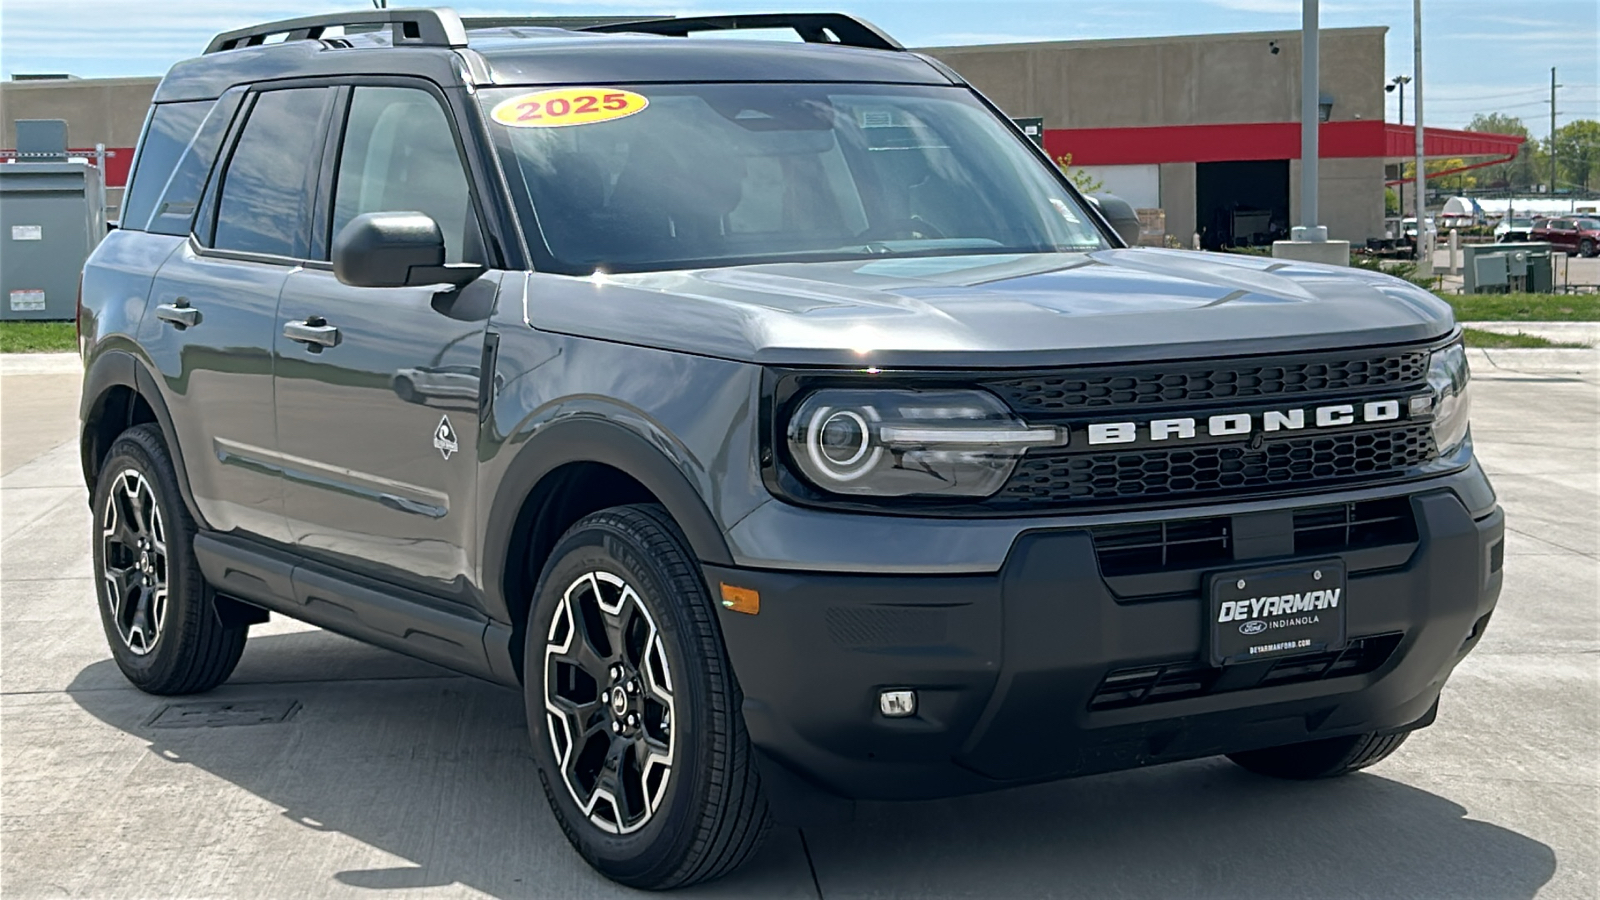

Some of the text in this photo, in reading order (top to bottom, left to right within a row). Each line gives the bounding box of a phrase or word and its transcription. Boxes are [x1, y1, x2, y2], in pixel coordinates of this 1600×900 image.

[516, 93, 628, 121] 2025
[1088, 400, 1399, 445] BRONCO
[1218, 588, 1340, 622] DEYARMAN
[1242, 615, 1320, 633] Ford INDIANOLA
[1249, 639, 1311, 654] DEYARMANFORD.COM
